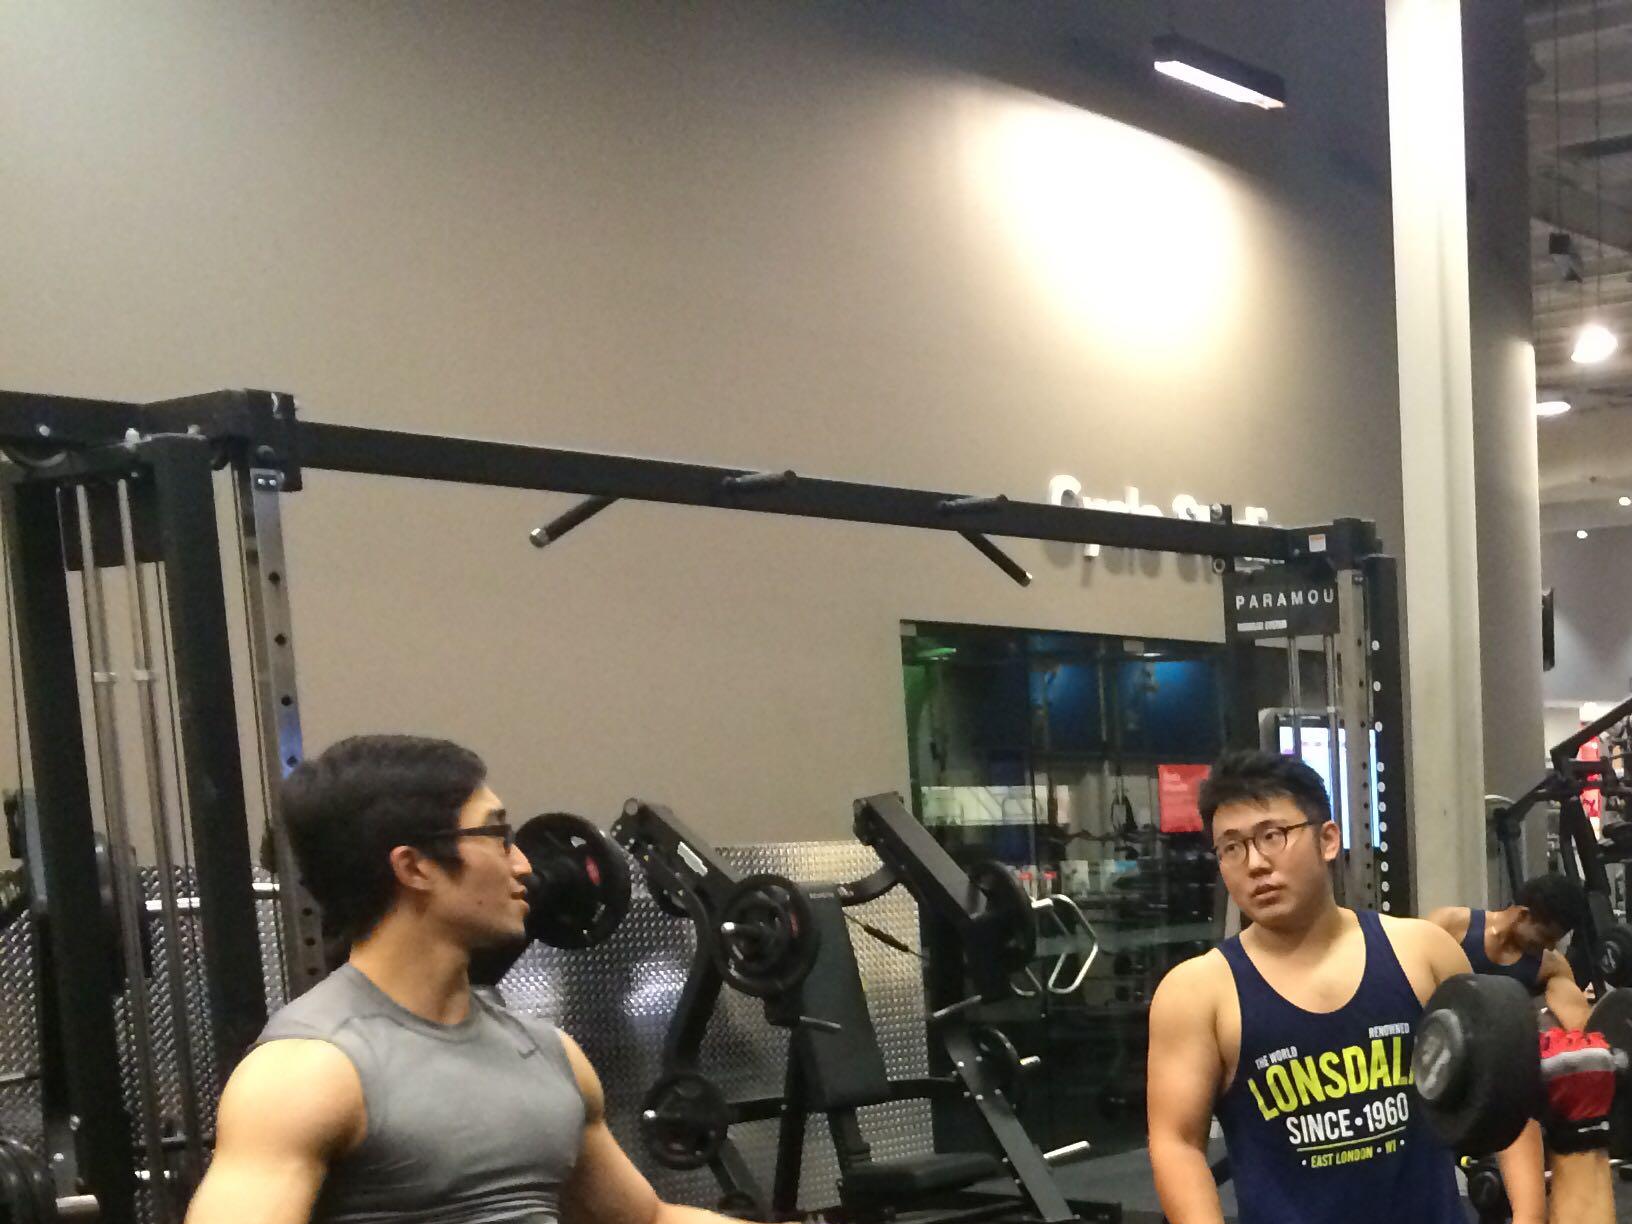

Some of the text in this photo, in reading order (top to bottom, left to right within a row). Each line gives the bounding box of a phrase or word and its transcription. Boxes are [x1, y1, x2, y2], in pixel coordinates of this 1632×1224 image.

[1236, 588, 1335, 610] PARAMOU
[1269, 1046, 1298, 1064] WORLD
[1247, 1036, 1415, 1121] LONSDAL
[1286, 1092, 1410, 1145] SINCE 1960
[1311, 1153, 1335, 1168] EAST
[1335, 1146, 1373, 1165] LONDON
